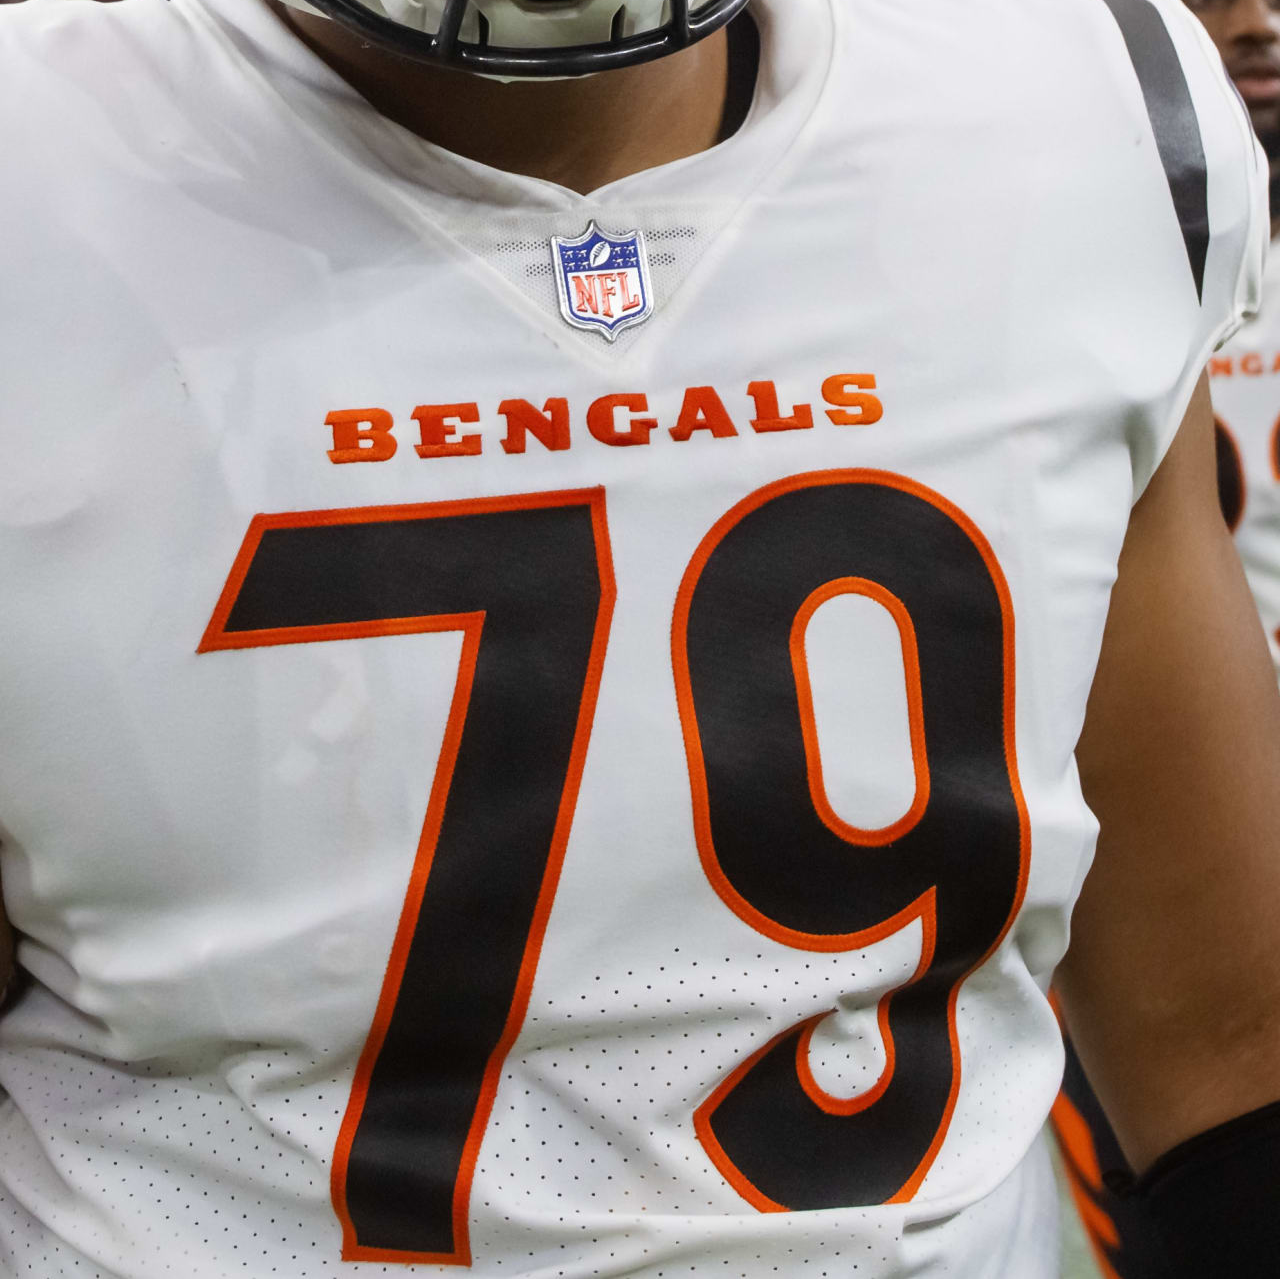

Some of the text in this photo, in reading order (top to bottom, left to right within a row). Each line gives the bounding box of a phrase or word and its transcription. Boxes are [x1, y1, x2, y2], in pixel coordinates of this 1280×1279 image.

[570, 270, 641, 319] NFL
[323, 372, 884, 464] BENGALS
[196, 467, 1032, 1267] 79
